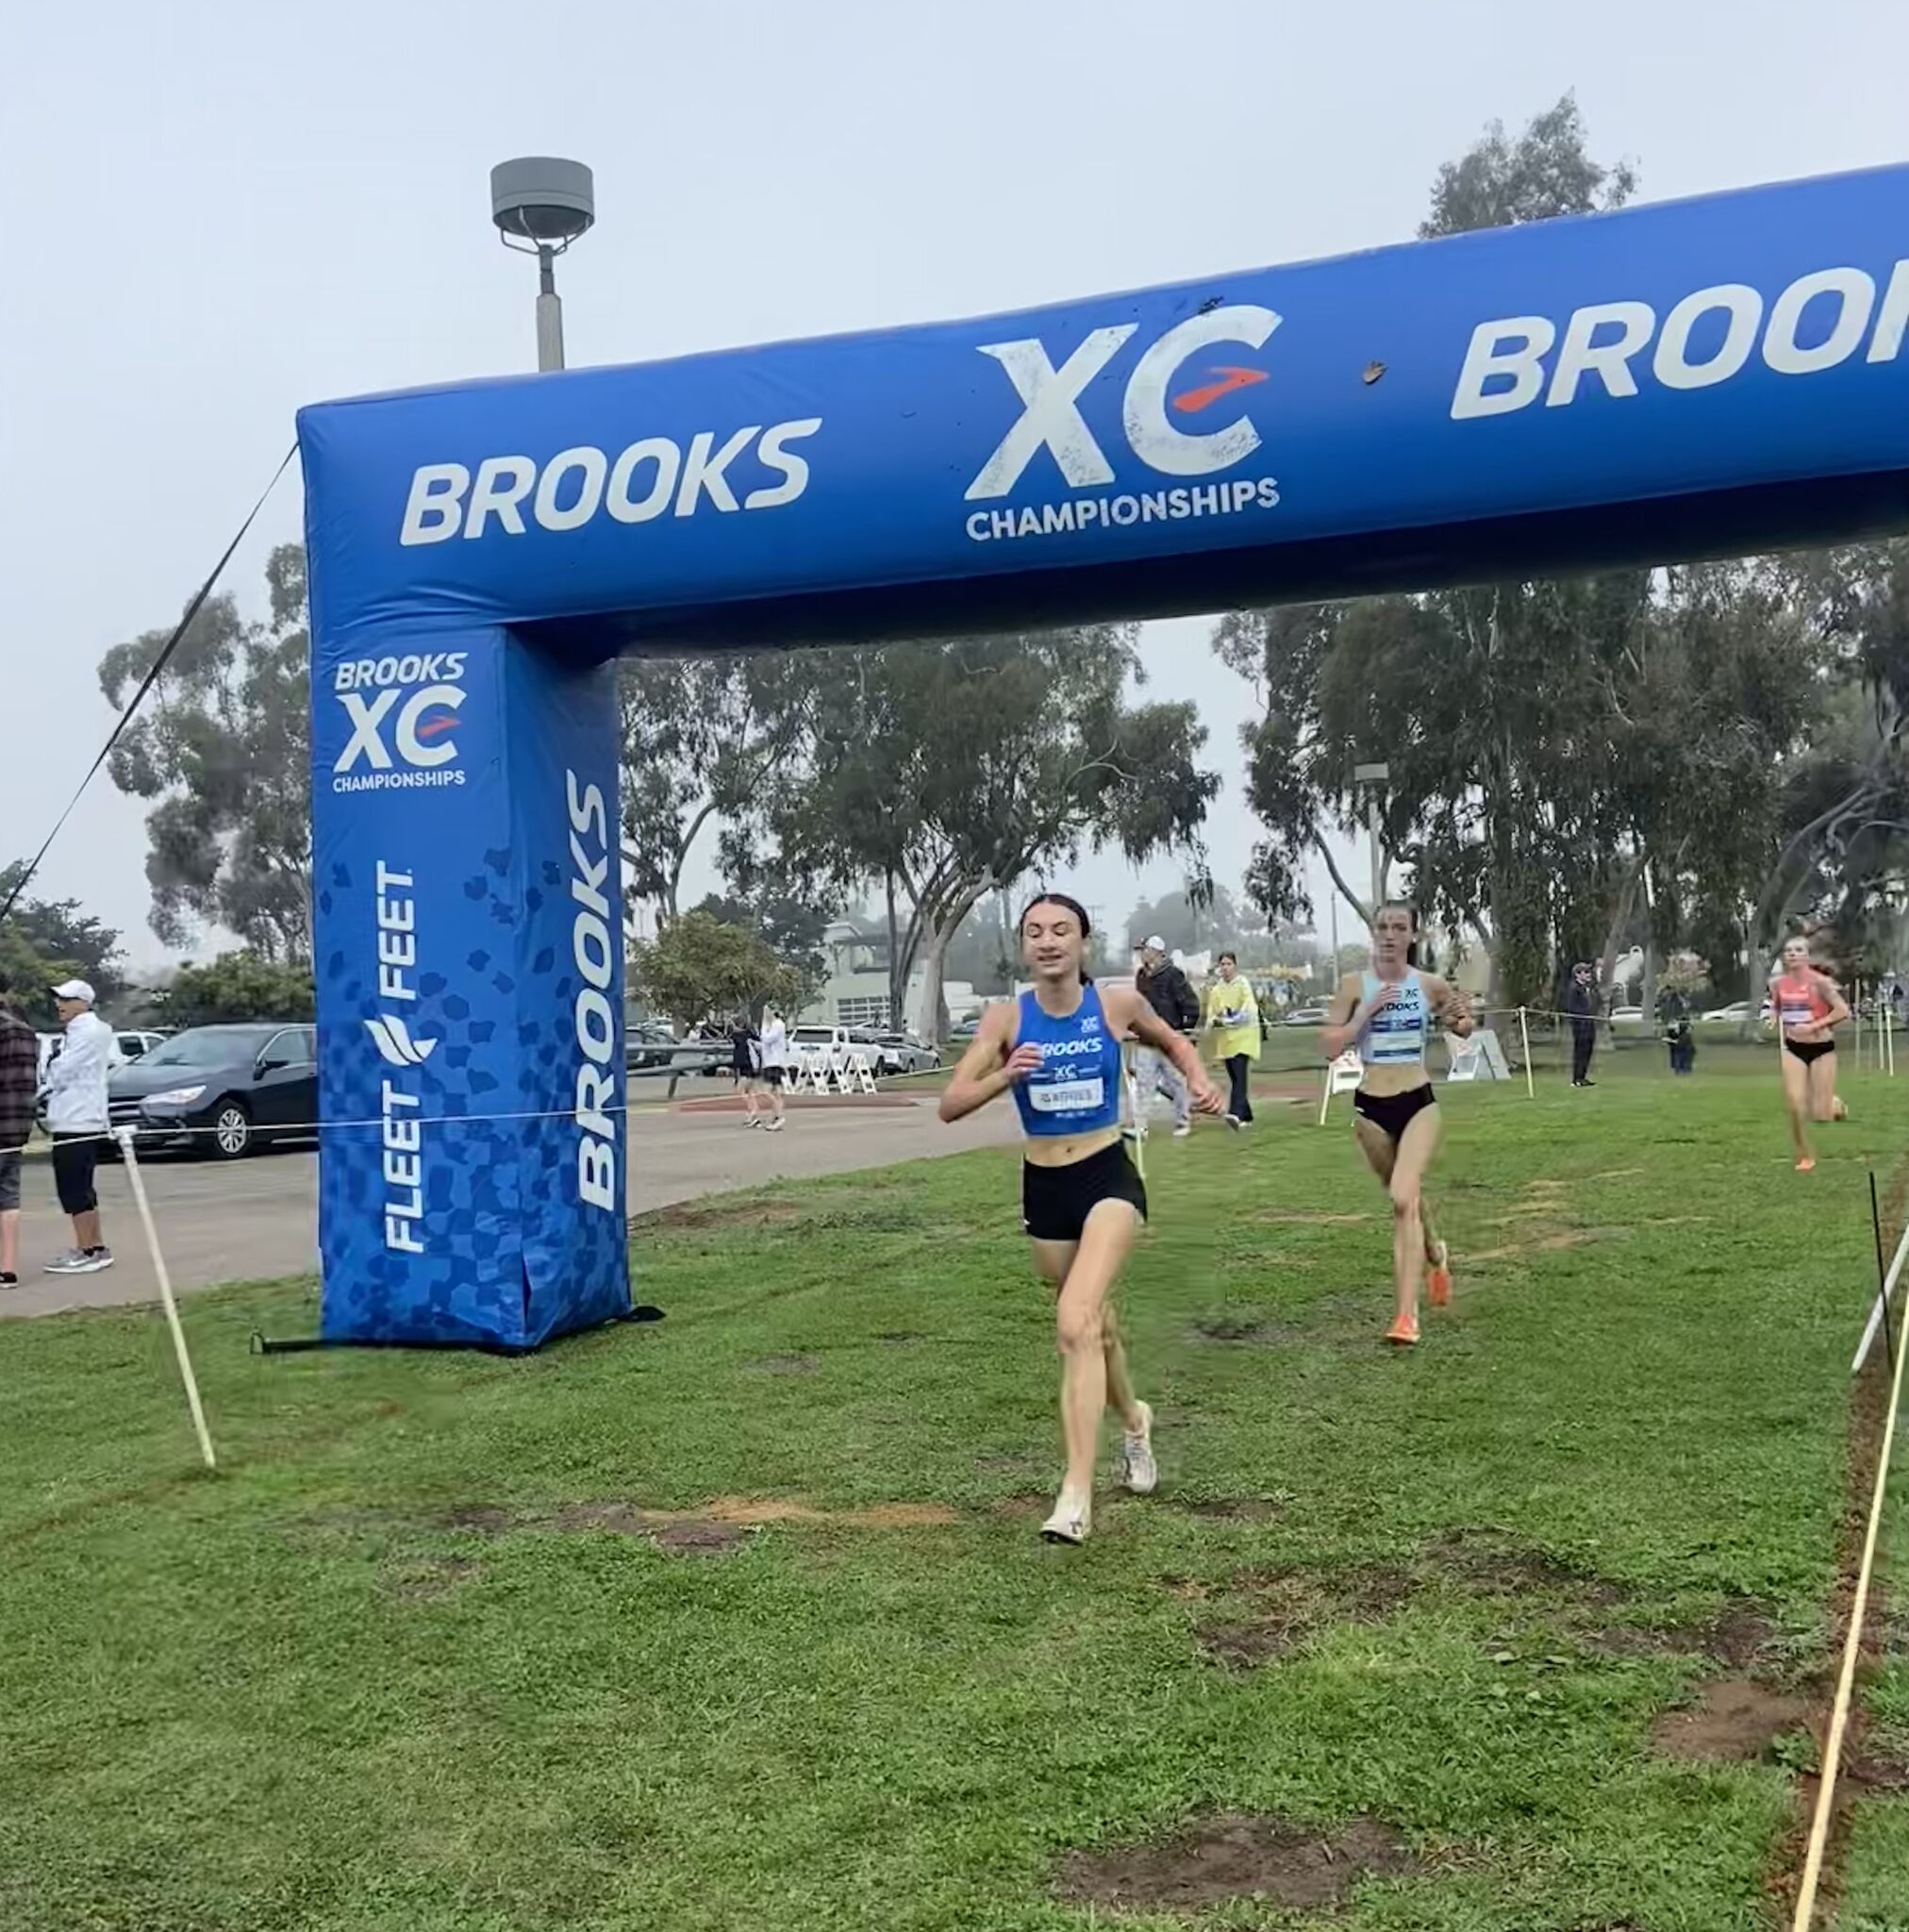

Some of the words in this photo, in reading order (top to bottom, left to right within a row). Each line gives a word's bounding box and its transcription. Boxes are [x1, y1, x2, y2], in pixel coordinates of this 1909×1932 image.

[964, 304, 1283, 500] XC
[400, 417, 822, 546] BROOKS
[965, 476, 1280, 541] CHAMPIONSHIPS
[333, 685, 468, 773] XC
[335, 652, 469, 690] BROOKS
[333, 770, 466, 792] CHAMPIONSHIPS
[376, 859, 416, 1001] FEET
[567, 769, 615, 1211] BROOKS
[383, 1080, 423, 1254] FLEET
